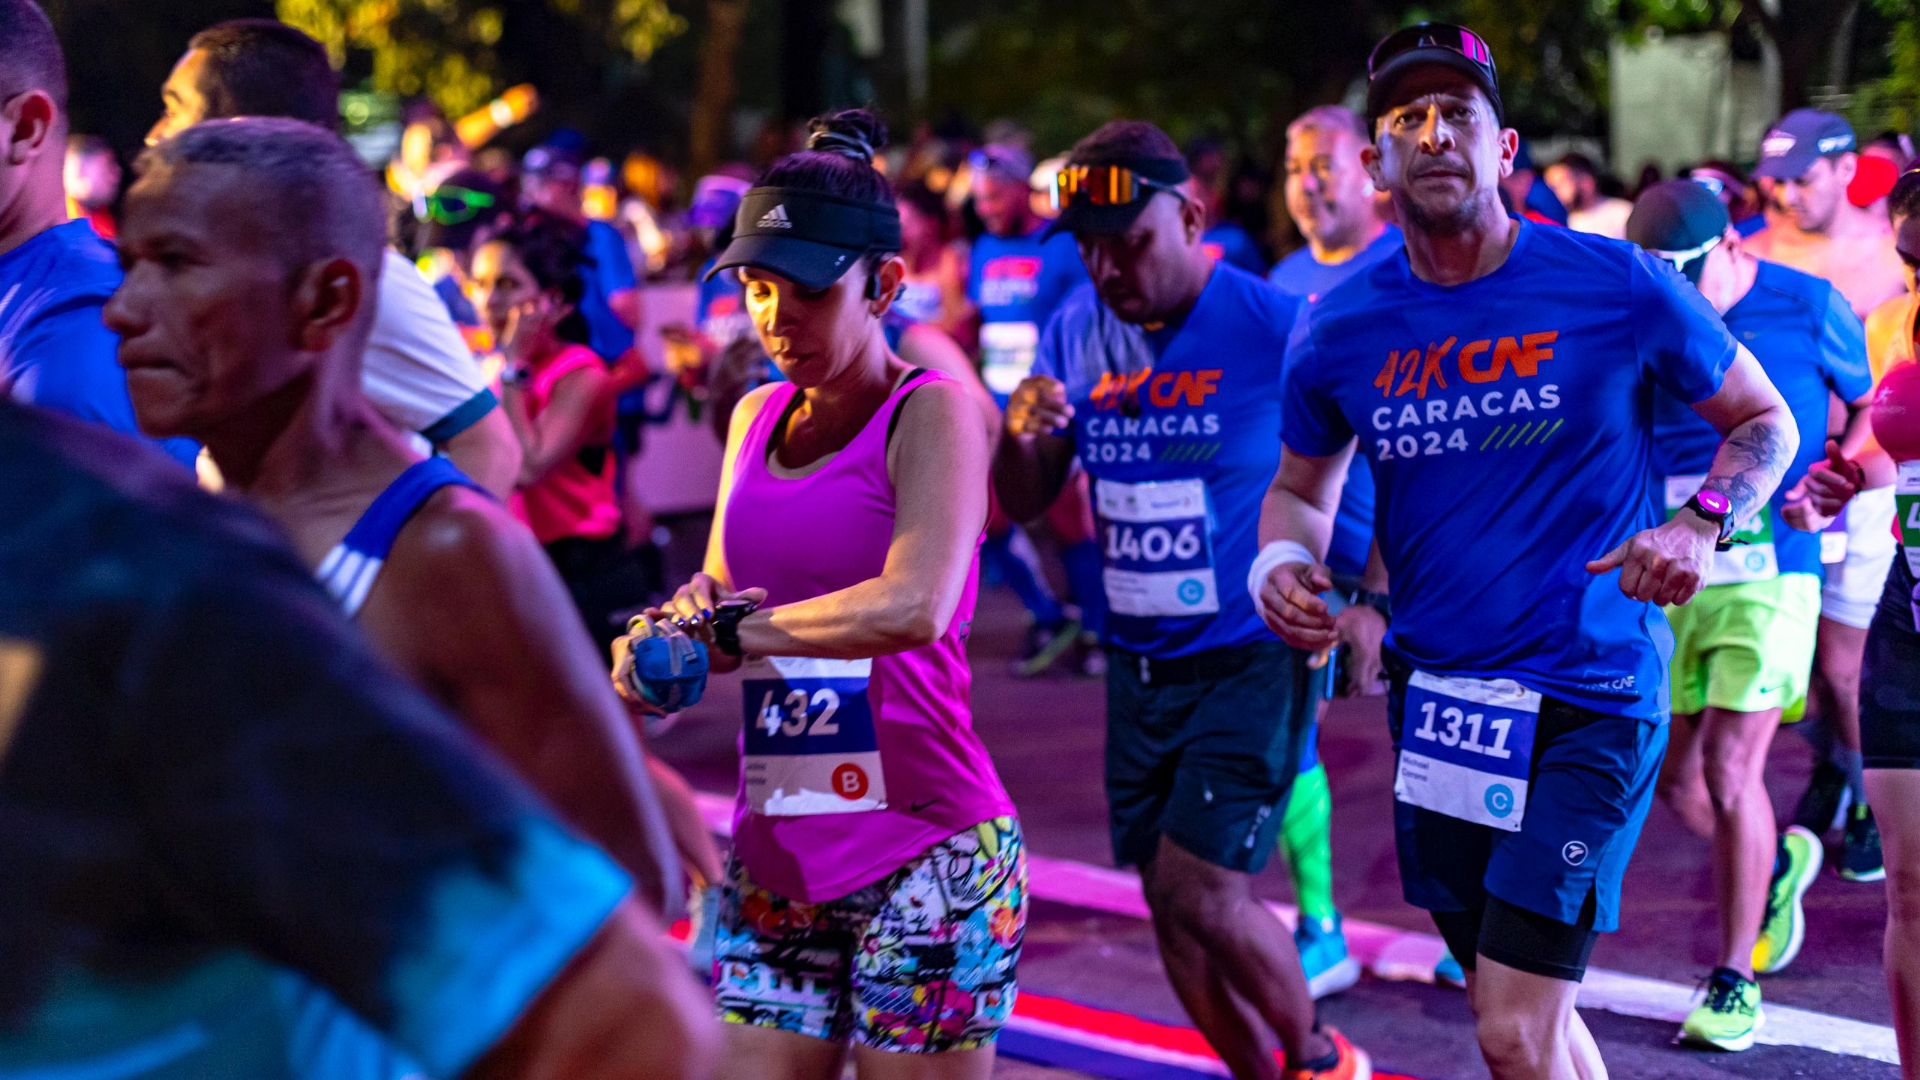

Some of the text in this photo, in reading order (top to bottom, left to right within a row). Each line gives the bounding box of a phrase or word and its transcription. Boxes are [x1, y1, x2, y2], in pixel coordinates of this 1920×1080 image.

[756, 220, 792, 229] adidas
[1458, 330, 1559, 384] CAF
[1149, 369, 1223, 408] CAF
[1086, 413, 1220, 438] CARACAS
[1372, 384, 1561, 431] CARACAS
[1086, 441, 1151, 463] 2024
[1376, 428, 1469, 461] 2024
[1106, 523, 1201, 562] 1406
[755, 688, 841, 738] 432
[1414, 701, 1513, 760] 1311
[840, 770, 861, 793] B
[1491, 791, 1509, 810] C
